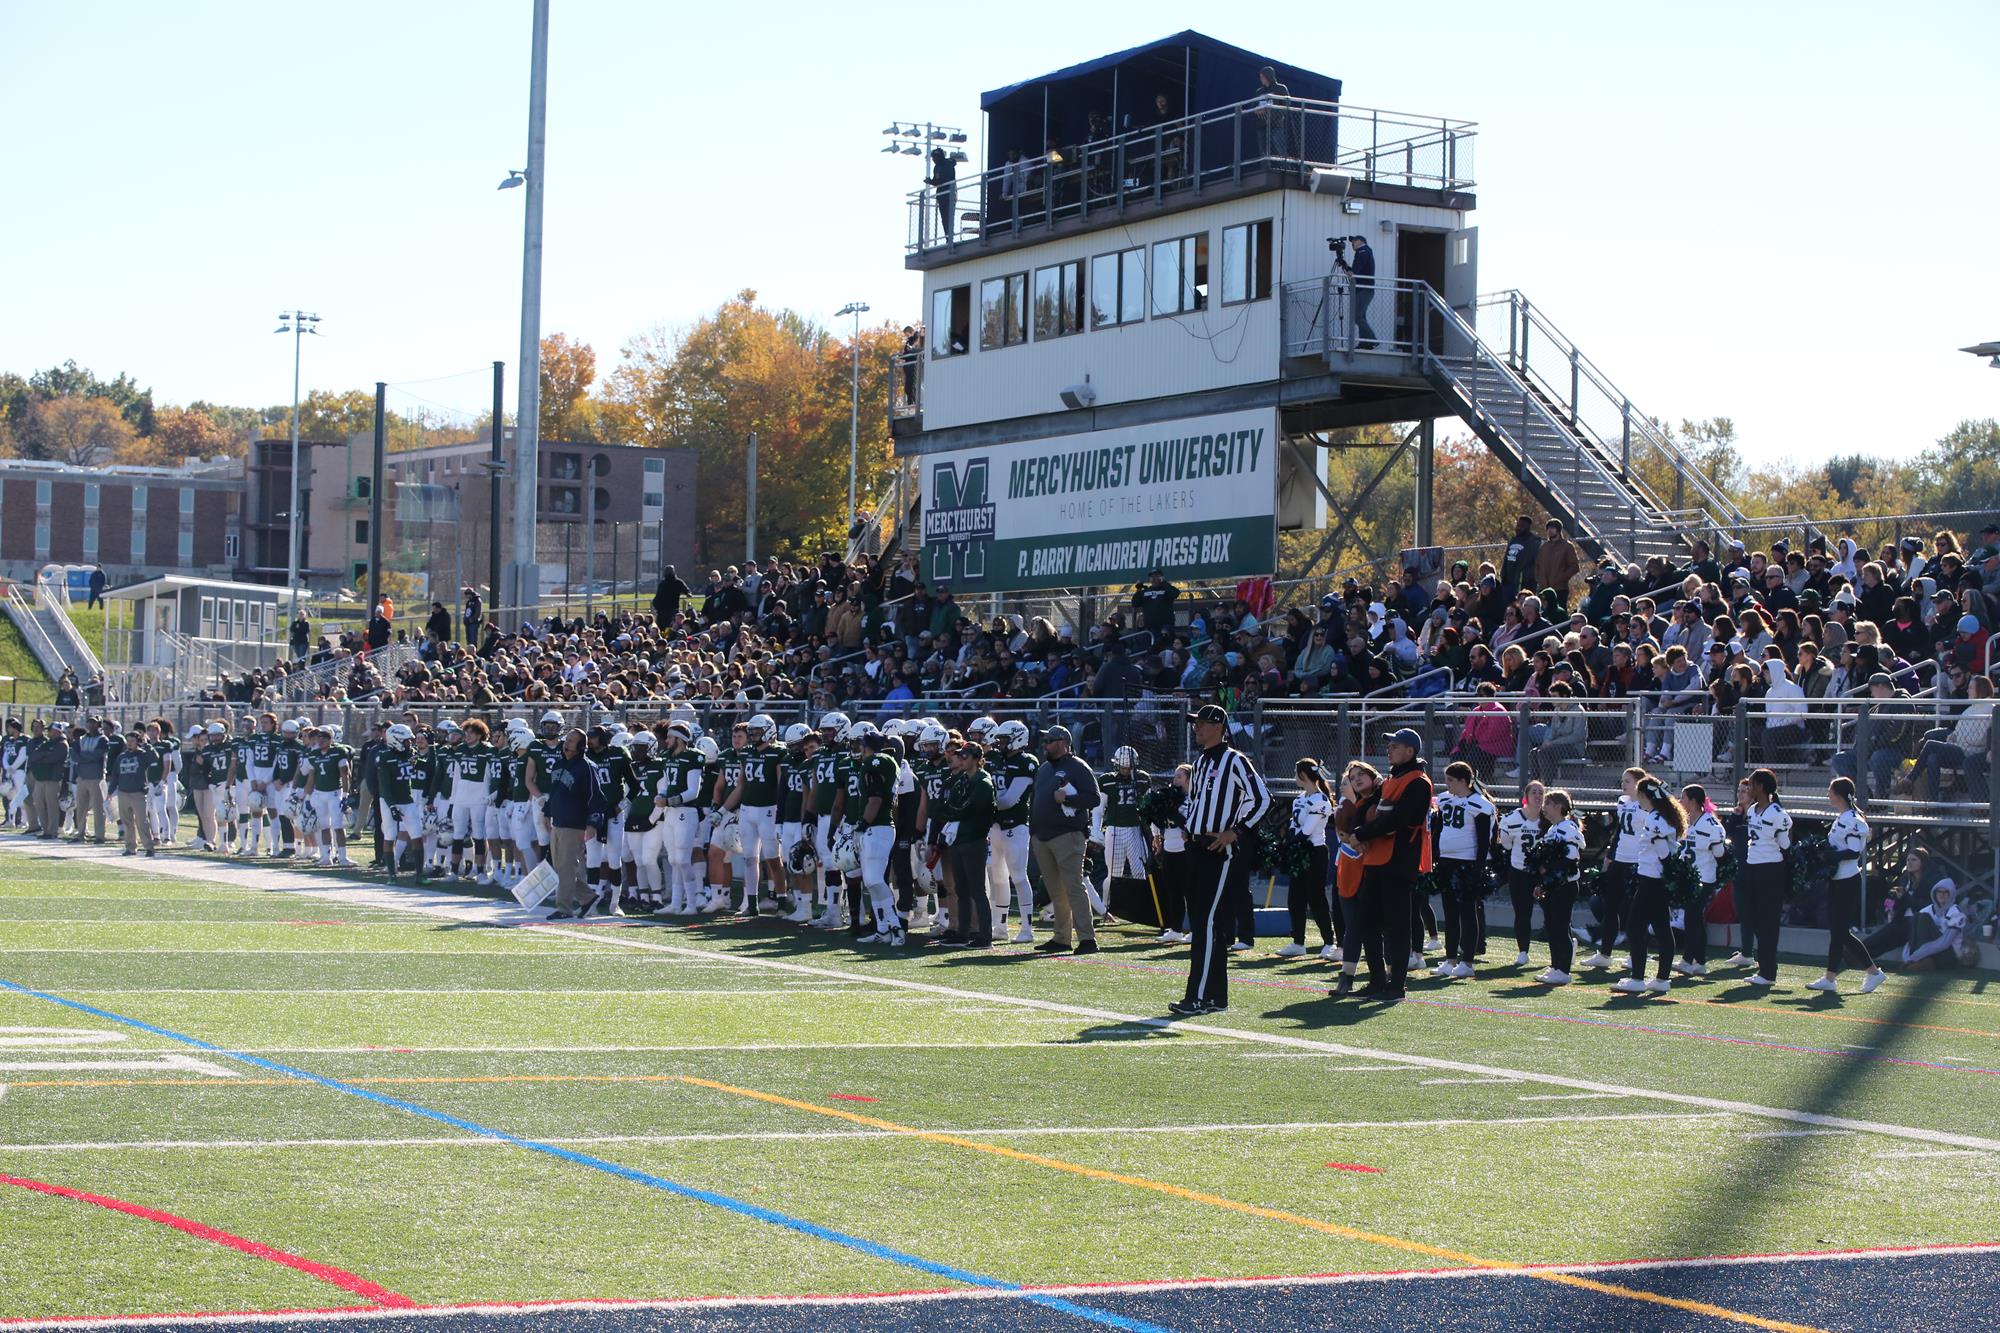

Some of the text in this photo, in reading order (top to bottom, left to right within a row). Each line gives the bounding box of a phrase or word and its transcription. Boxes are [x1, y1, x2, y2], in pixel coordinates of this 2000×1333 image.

[1008, 428, 1264, 500] MERCYHURST UNIVERSITY
[1060, 489, 1195, 520] HOME OF THE LAKERS
[926, 506, 994, 535] MERCYHURST
[948, 532, 972, 542] UNIVERSITY
[1017, 533, 1232, 578] P. BARRY McANDREW PRESS BOX
[212, 756, 227, 771] 47
[254, 746, 269, 761] 52
[319, 763, 327, 775] 1
[744, 762, 766, 783] 84
[816, 762, 836, 784] 64
[1117, 788, 1137, 805] 12
[1441, 804, 1466, 829] 28
